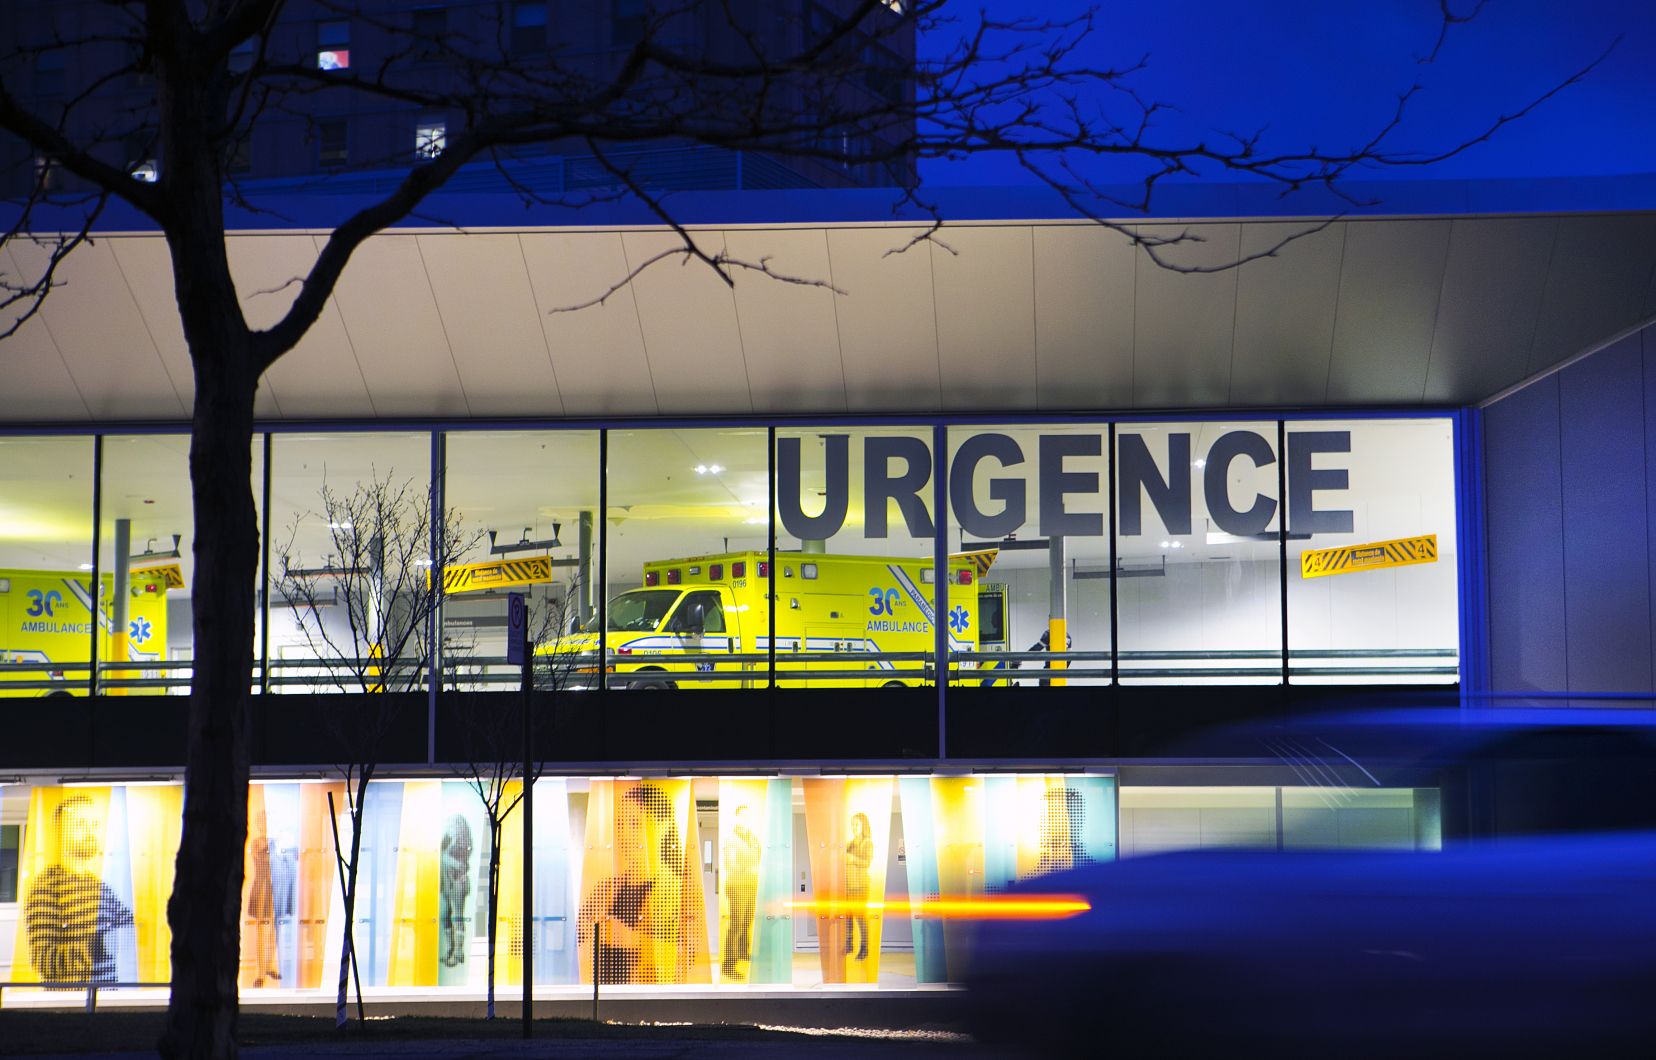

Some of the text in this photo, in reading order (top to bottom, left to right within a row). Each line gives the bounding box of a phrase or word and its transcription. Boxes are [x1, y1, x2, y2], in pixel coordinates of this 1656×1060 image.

[777, 430, 1354, 540] URGENCE
[1418, 544, 1425, 554] 4
[1315, 555, 1321, 566] 4
[533, 565, 540, 574] 2
[733, 580, 746, 588] 0196
[26, 589, 62, 616] 30
[869, 587, 900, 616] 30
[21, 622, 92, 633] AMBULANCE
[867, 620, 928, 633] AMBULANCE
